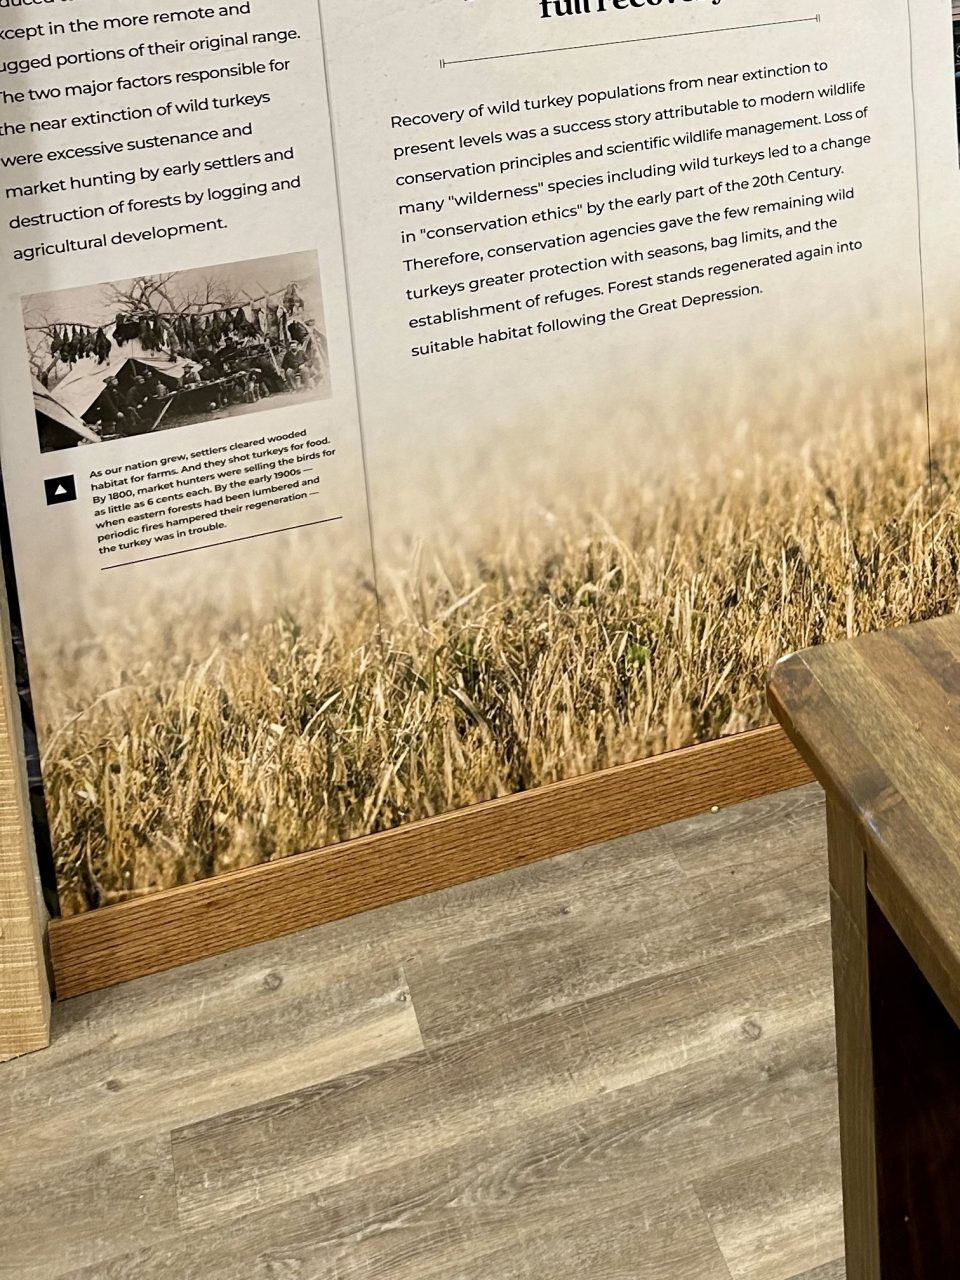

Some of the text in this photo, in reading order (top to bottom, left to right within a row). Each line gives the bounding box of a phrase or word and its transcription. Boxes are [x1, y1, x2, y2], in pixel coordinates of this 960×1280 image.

[13, 218, 227, 261] agricultural development.
[411, 285, 763, 357] suitable habitat following the Great Depression.
[105, 467, 122, 475] our
[125, 460, 158, 471] nation
[160, 454, 188, 466] grew,
[190, 446, 227, 458] settlers
[229, 437, 265, 451] cleared
[267, 429, 307, 443] wooded
[98, 522, 227, 554] the turkey was in trouble.
